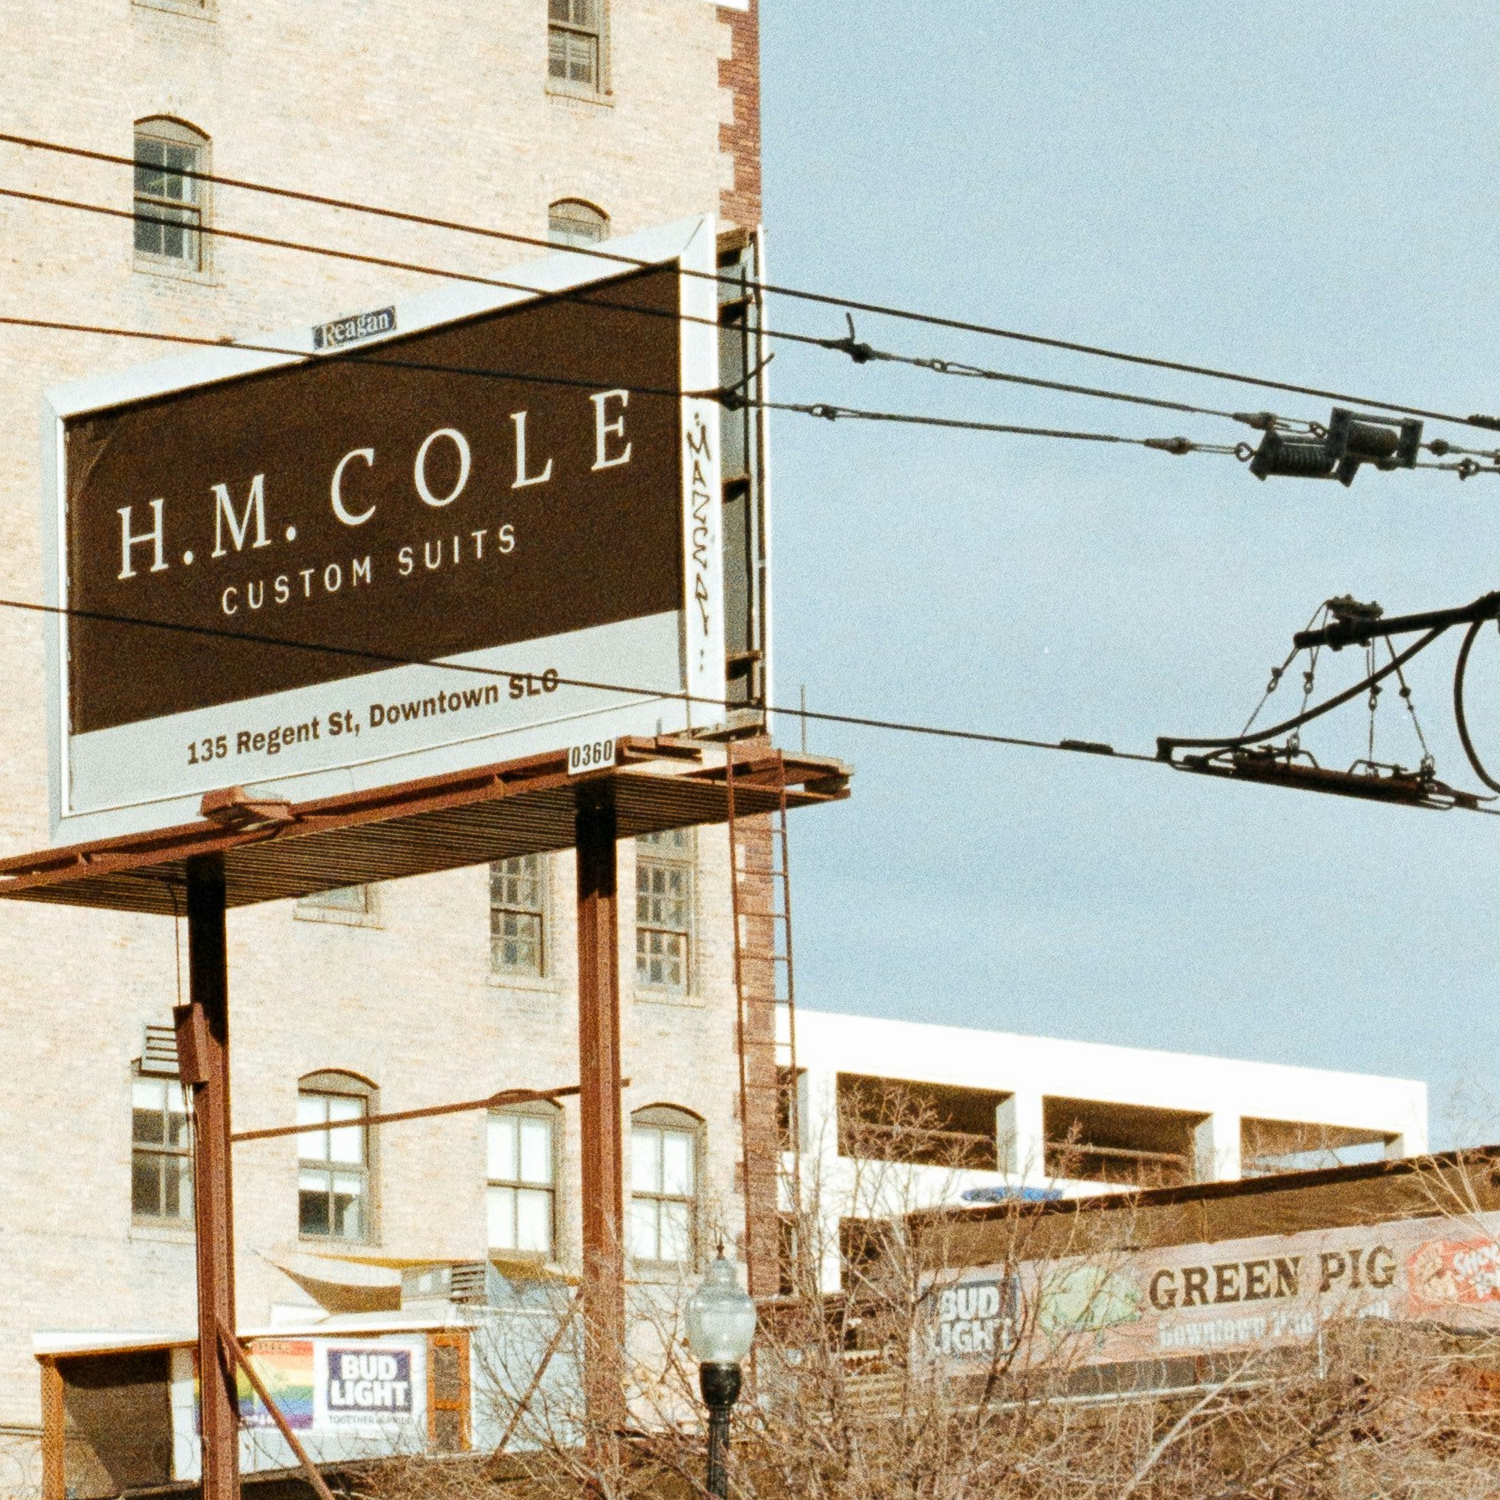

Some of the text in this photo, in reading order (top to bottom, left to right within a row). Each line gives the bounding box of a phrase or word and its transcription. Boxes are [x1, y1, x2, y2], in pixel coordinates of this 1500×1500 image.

[322, 313, 390, 349] Reagan
[117, 389, 634, 580] H.M. COLE
[222, 524, 516, 616] CUSTOM SUITS
[187, 735, 228, 766] 135
[236, 720, 320, 755] Regent
[328, 710, 361, 737] St,
[369, 683, 500, 729] Downtown
[571, 740, 613, 769] 0360
[1149, 1256, 1301, 1311] GREEN
[1319, 1246, 1397, 1292] PIG
[940, 1286, 999, 1321] BUD
[341, 1354, 398, 1380] BUD
[331, 1380, 408, 1406] LIGHT
